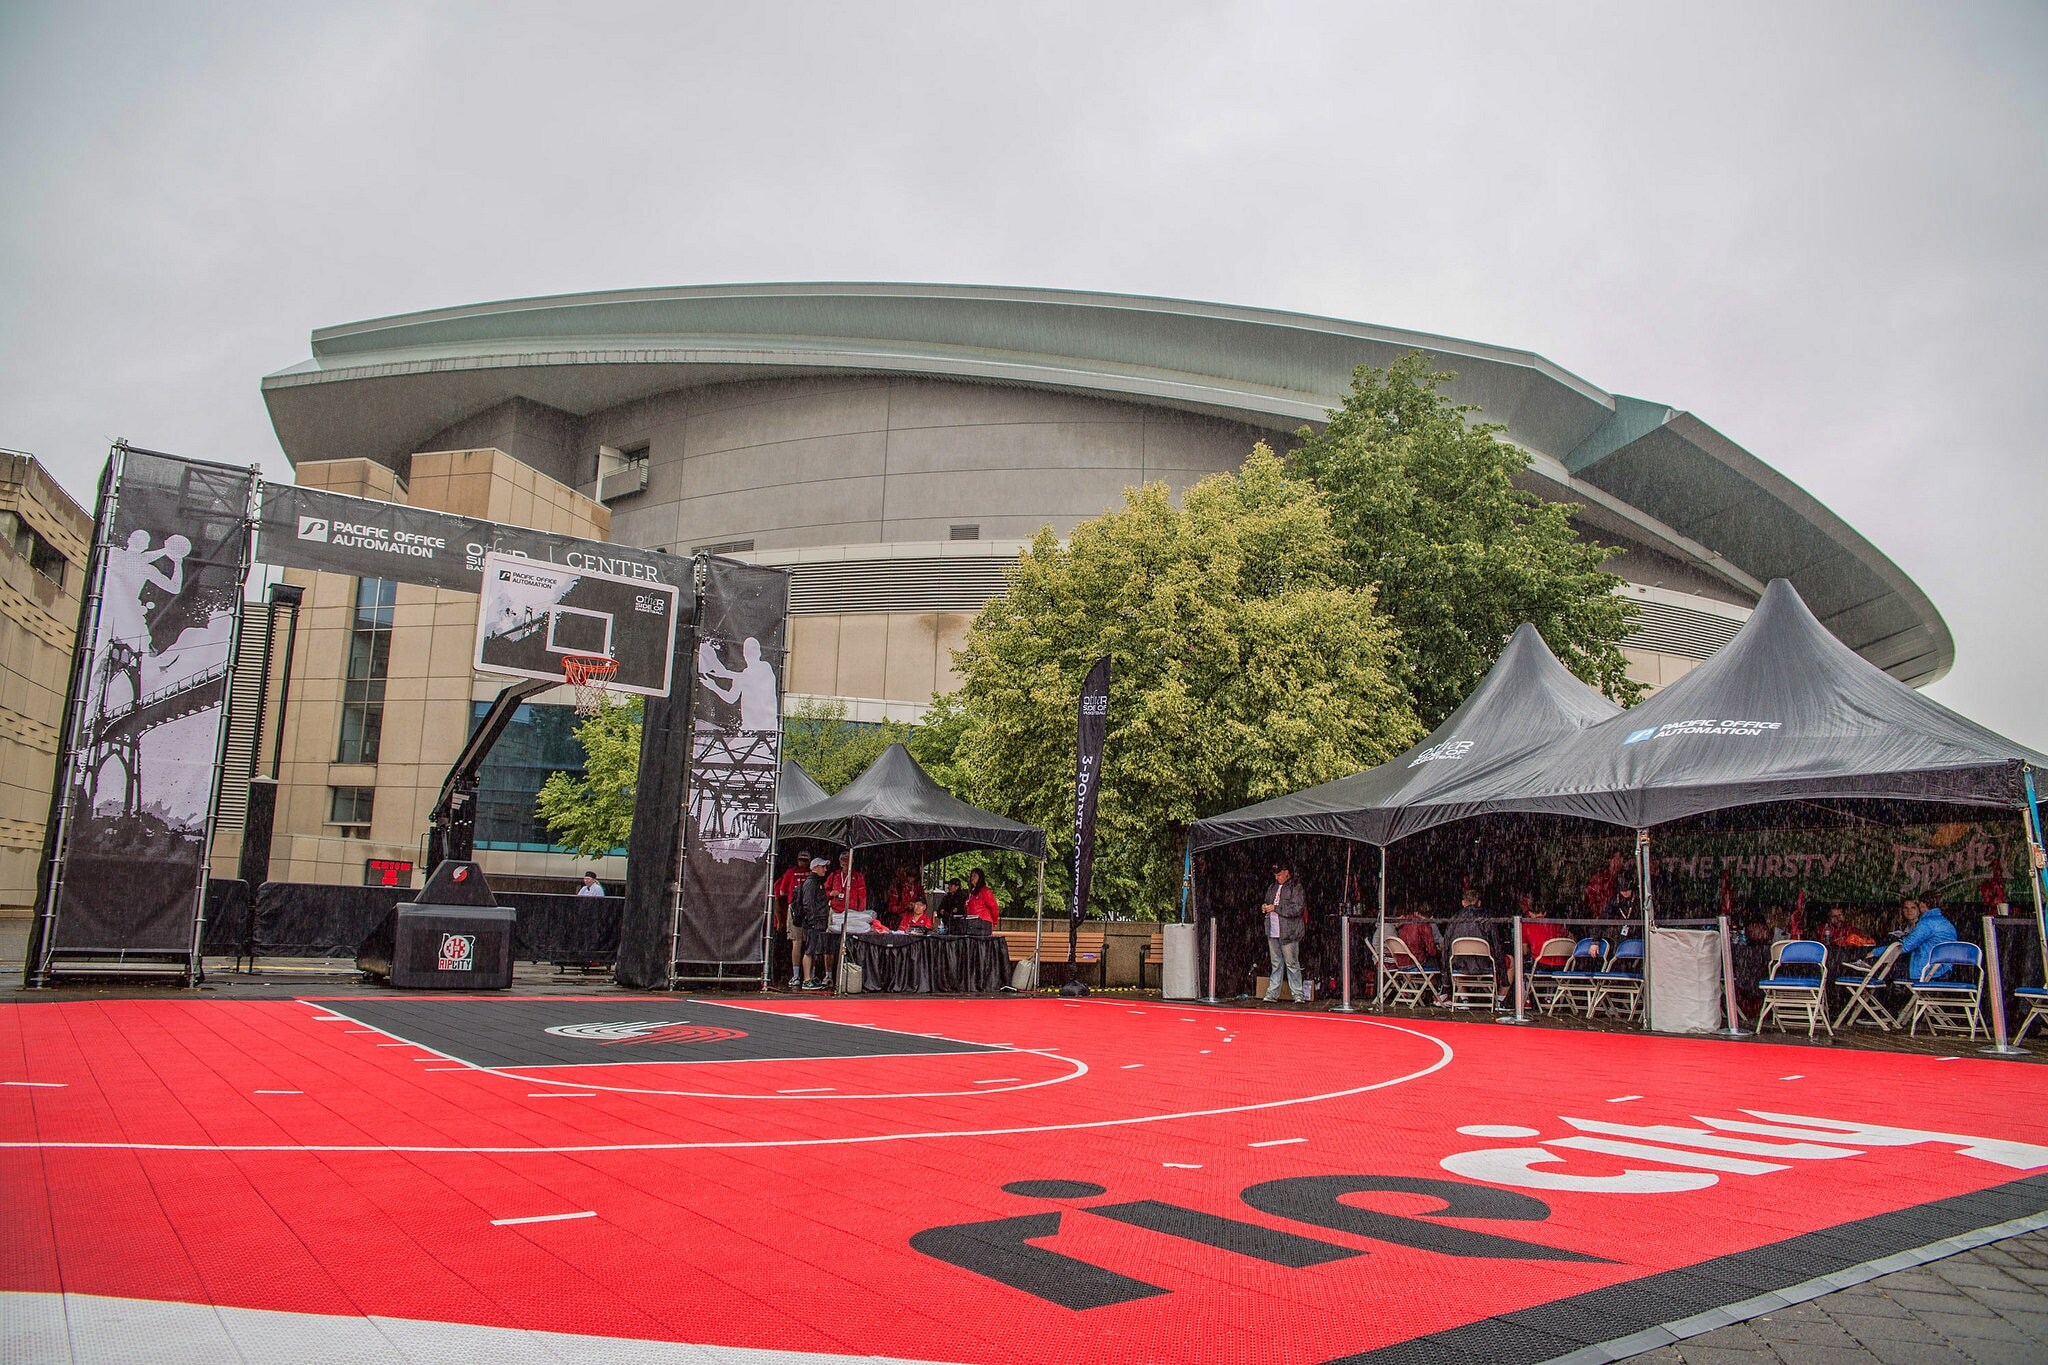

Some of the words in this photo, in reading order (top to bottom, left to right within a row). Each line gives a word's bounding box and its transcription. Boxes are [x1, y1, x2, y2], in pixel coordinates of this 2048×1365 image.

[332, 534, 433, 559] AUTOMATION
[333, 521, 389, 540] PACIFIC
[393, 531, 446, 549] OFFICE
[513, 572, 534, 581] PACIFIC
[536, 576, 557, 585] OFFICE
[566, 552, 659, 583] CENTER
[512, 578, 552, 590] AUTOMATION
[1653, 727, 1762, 739] AUTOMATION
[1659, 720, 1718, 732] PACIFIC
[1721, 720, 1782, 730] OFFICE
[1075, 755, 1093, 829] 3-POINT
[1899, 834, 1996, 895] Sprite
